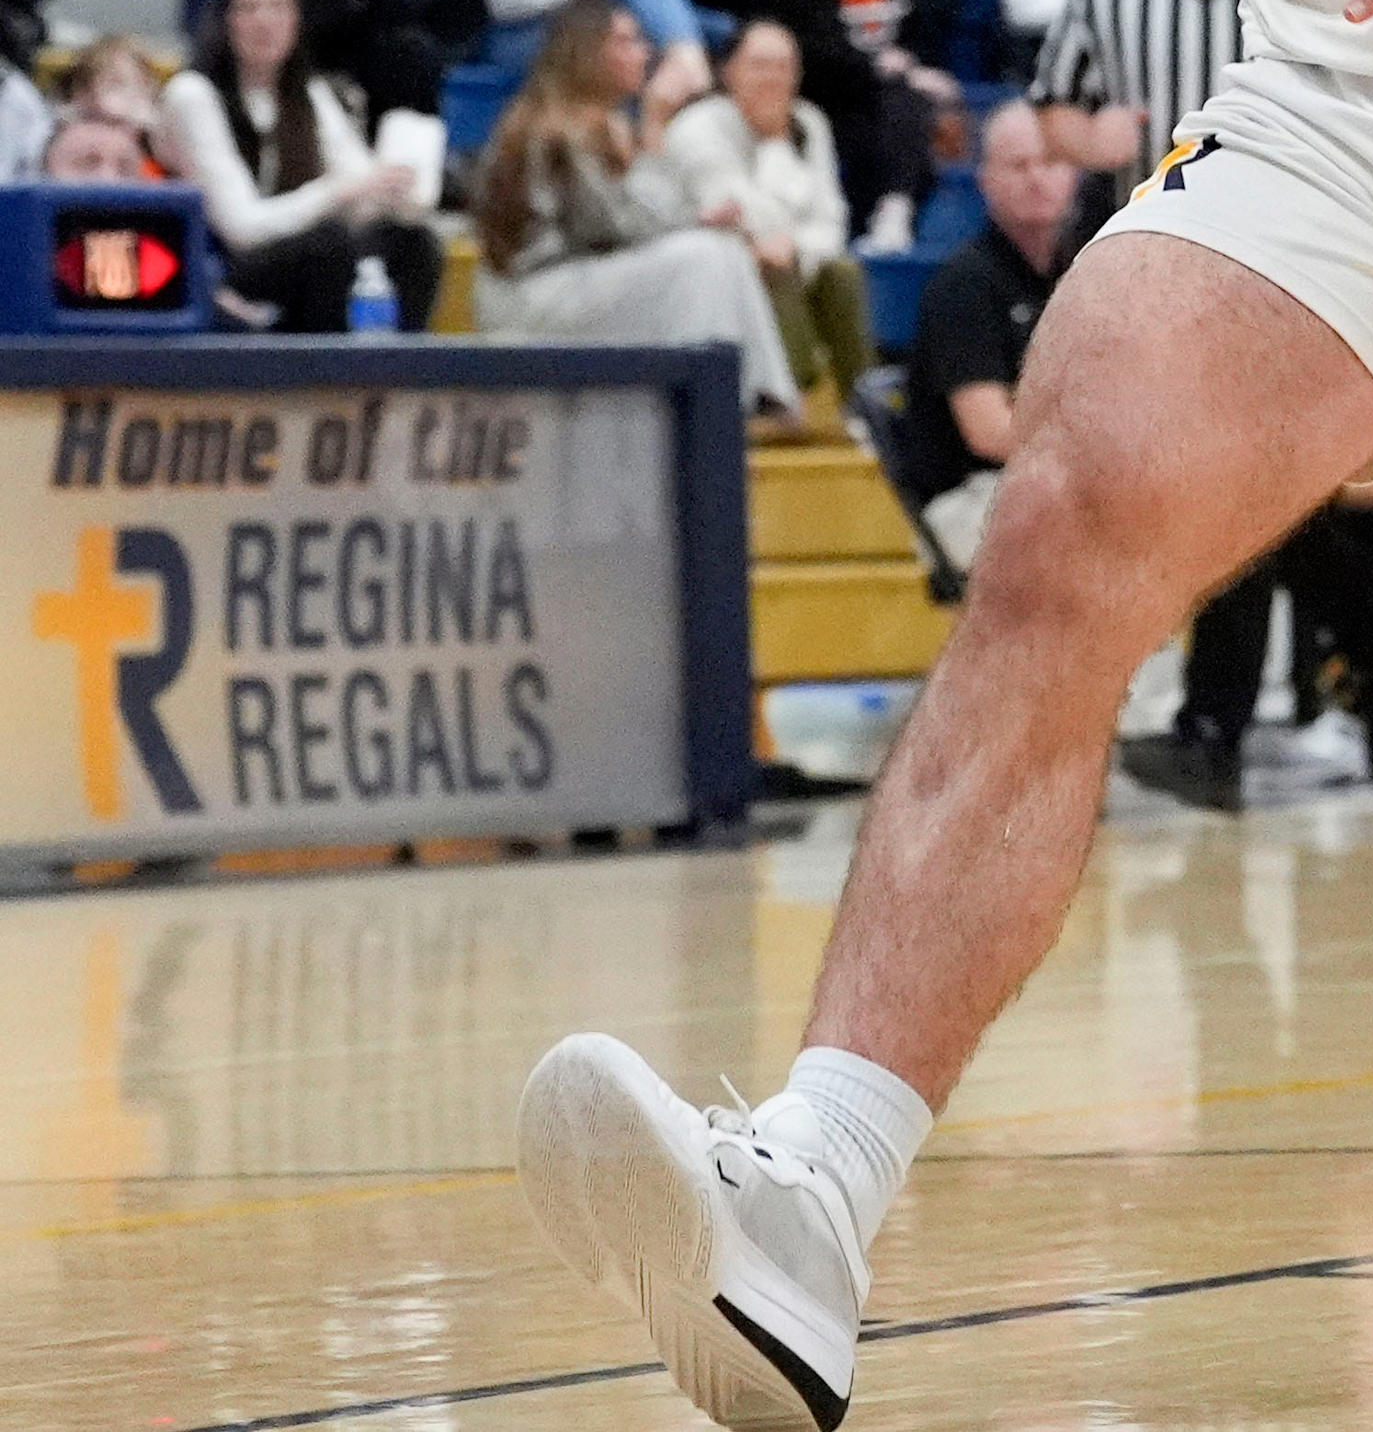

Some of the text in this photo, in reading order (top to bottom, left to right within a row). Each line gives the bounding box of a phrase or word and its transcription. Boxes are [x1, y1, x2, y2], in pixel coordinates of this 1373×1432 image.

[50, 392, 532, 489] Home of the
[225, 514, 535, 652] REGINA
[227, 662, 555, 808] REGALS
